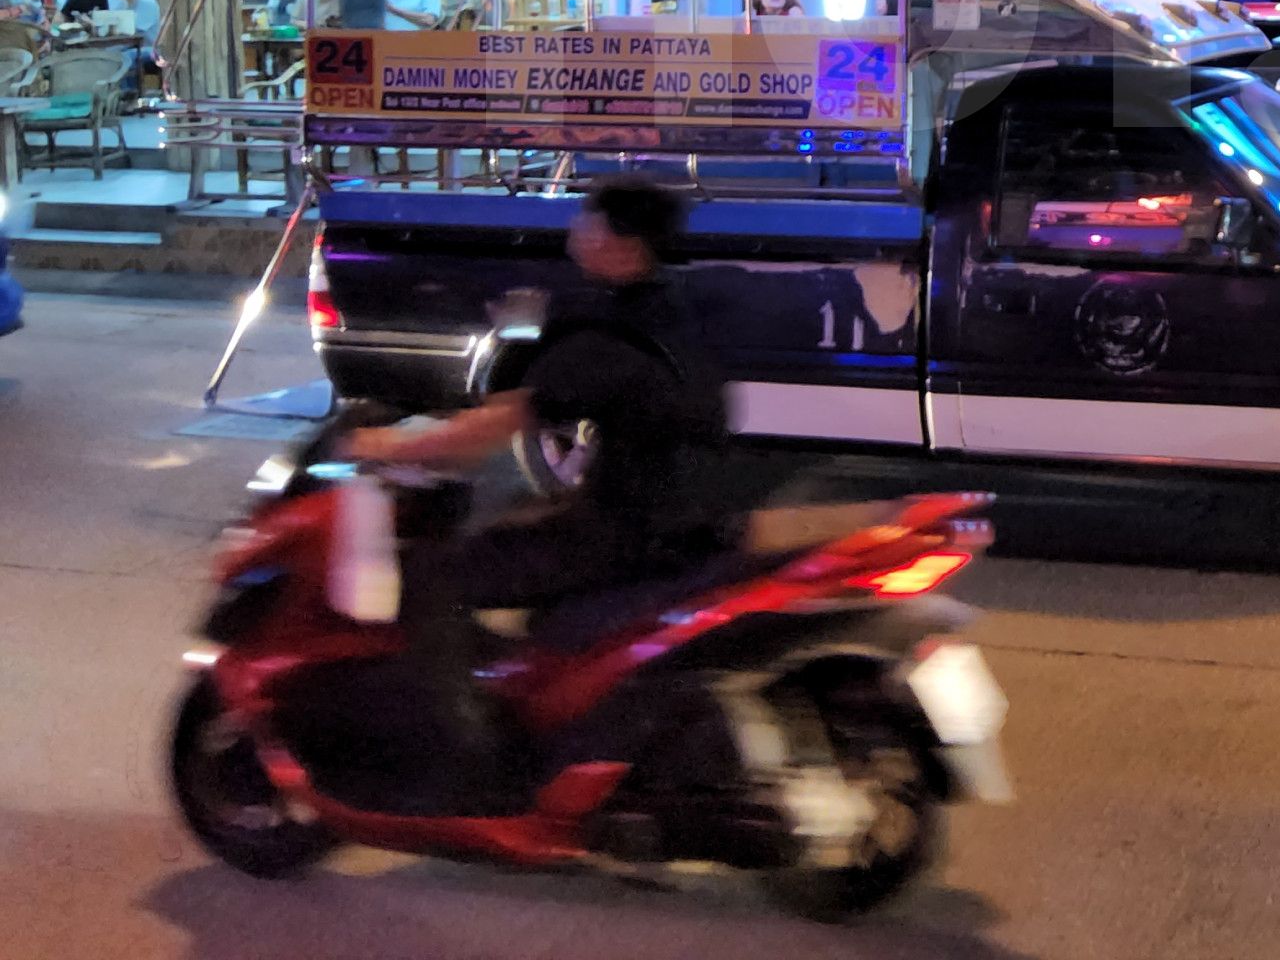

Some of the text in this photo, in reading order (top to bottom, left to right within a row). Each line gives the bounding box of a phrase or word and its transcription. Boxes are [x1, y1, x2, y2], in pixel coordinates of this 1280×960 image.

[314, 40, 368, 74] 24
[479, 35, 711, 56] BEST RATES IN PATTAYA
[826, 45, 888, 81] 24
[383, 67, 813, 95] DAMINI MONEY EXCHANGE AND GOLD SHOP
[310, 86, 374, 108] OPEN
[817, 94, 894, 119] OPEN
